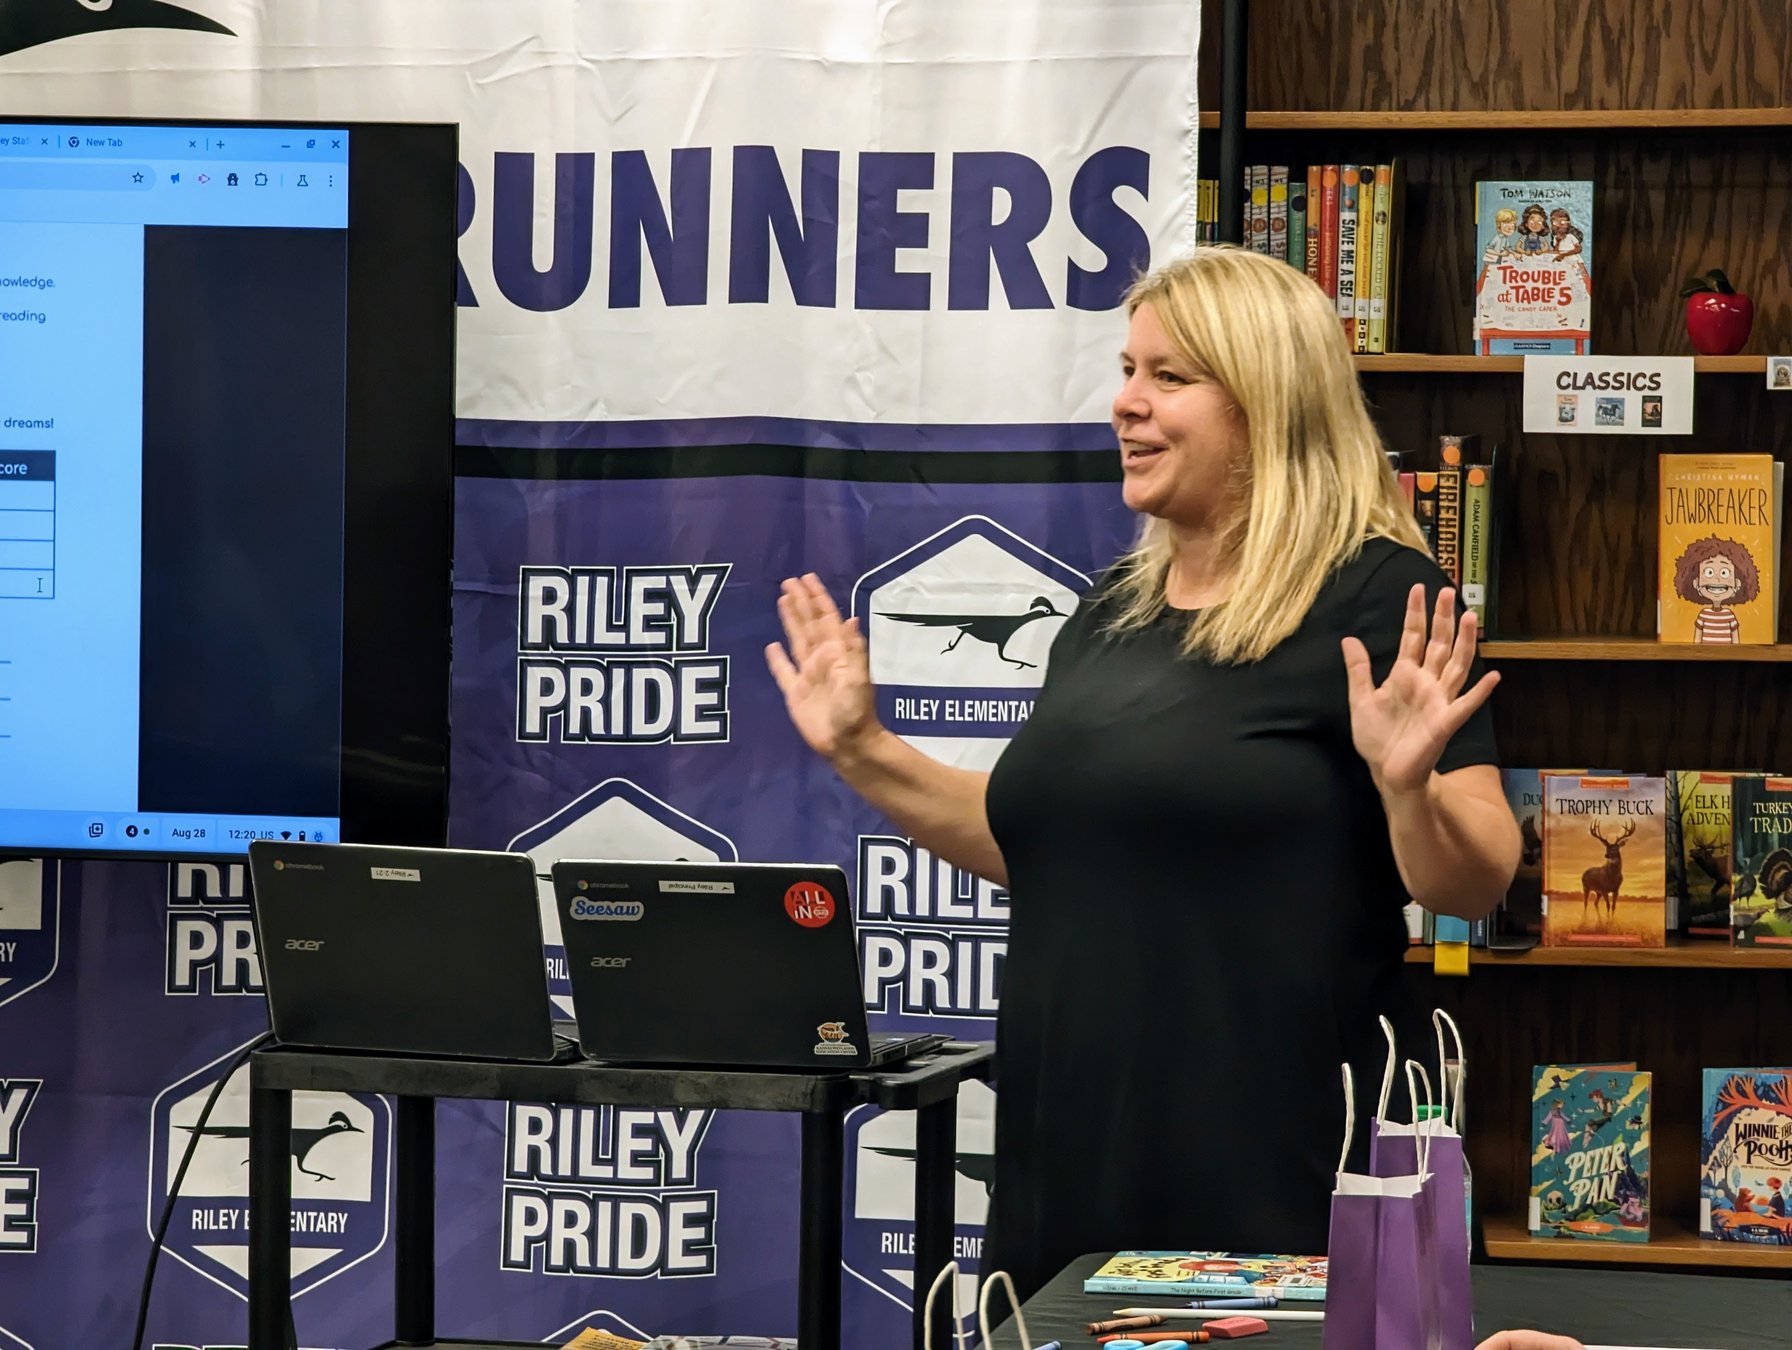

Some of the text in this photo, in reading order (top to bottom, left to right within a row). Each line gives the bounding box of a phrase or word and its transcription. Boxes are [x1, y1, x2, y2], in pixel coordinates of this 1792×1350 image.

[86, 138, 123, 147] New Tab
[1500, 187, 1571, 198] TOM WATSON
[458, 145, 1151, 312] UNNERS
[1341, 219, 1356, 246] SAVE
[1308, 238, 1318, 280] HONE
[1341, 250, 1354, 265] ME
[0, 275, 56, 290] owledge.
[1497, 265, 1566, 286] TROUBLE
[1340, 280, 1353, 297] SEA
[1498, 285, 1572, 306] at TABLE 5
[1556, 371, 1661, 391] CLASSICS
[4, 417, 54, 429] dreams!
[0, 463, 28, 475] core
[1472, 499, 1481, 523] ADAM
[1665, 487, 1769, 526] JAWBREAKER
[1471, 525, 1480, 561] CANFIELD
[526, 573, 718, 645] RILEY
[525, 666, 720, 735] PRIDE
[895, 698, 1035, 722] RILEY ELEMENTA
[1523, 793, 1542, 806] DU
[1556, 798, 1654, 816] TROPHY BUCK
[1695, 795, 1718, 809] ELK
[1686, 812, 1730, 825] ADVEN
[172, 828, 206, 840] Aug 28
[228, 830, 274, 840] 12:20 US
[866, 845, 1010, 919] RILE
[575, 900, 640, 916] Seesaw
[285, 938, 325, 951] acer
[546, 958, 569, 979] RIL
[590, 956, 632, 968] acer
[864, 937, 1008, 1010] PRID
[513, 1105, 706, 1180] RILEY
[1563, 1142, 1628, 1185] PETER
[1568, 1171, 1622, 1212] PAN
[192, 1209, 239, 1230] RILEY
[510, 1194, 708, 1270] PRIDE
[881, 1232, 915, 1254] RILE
